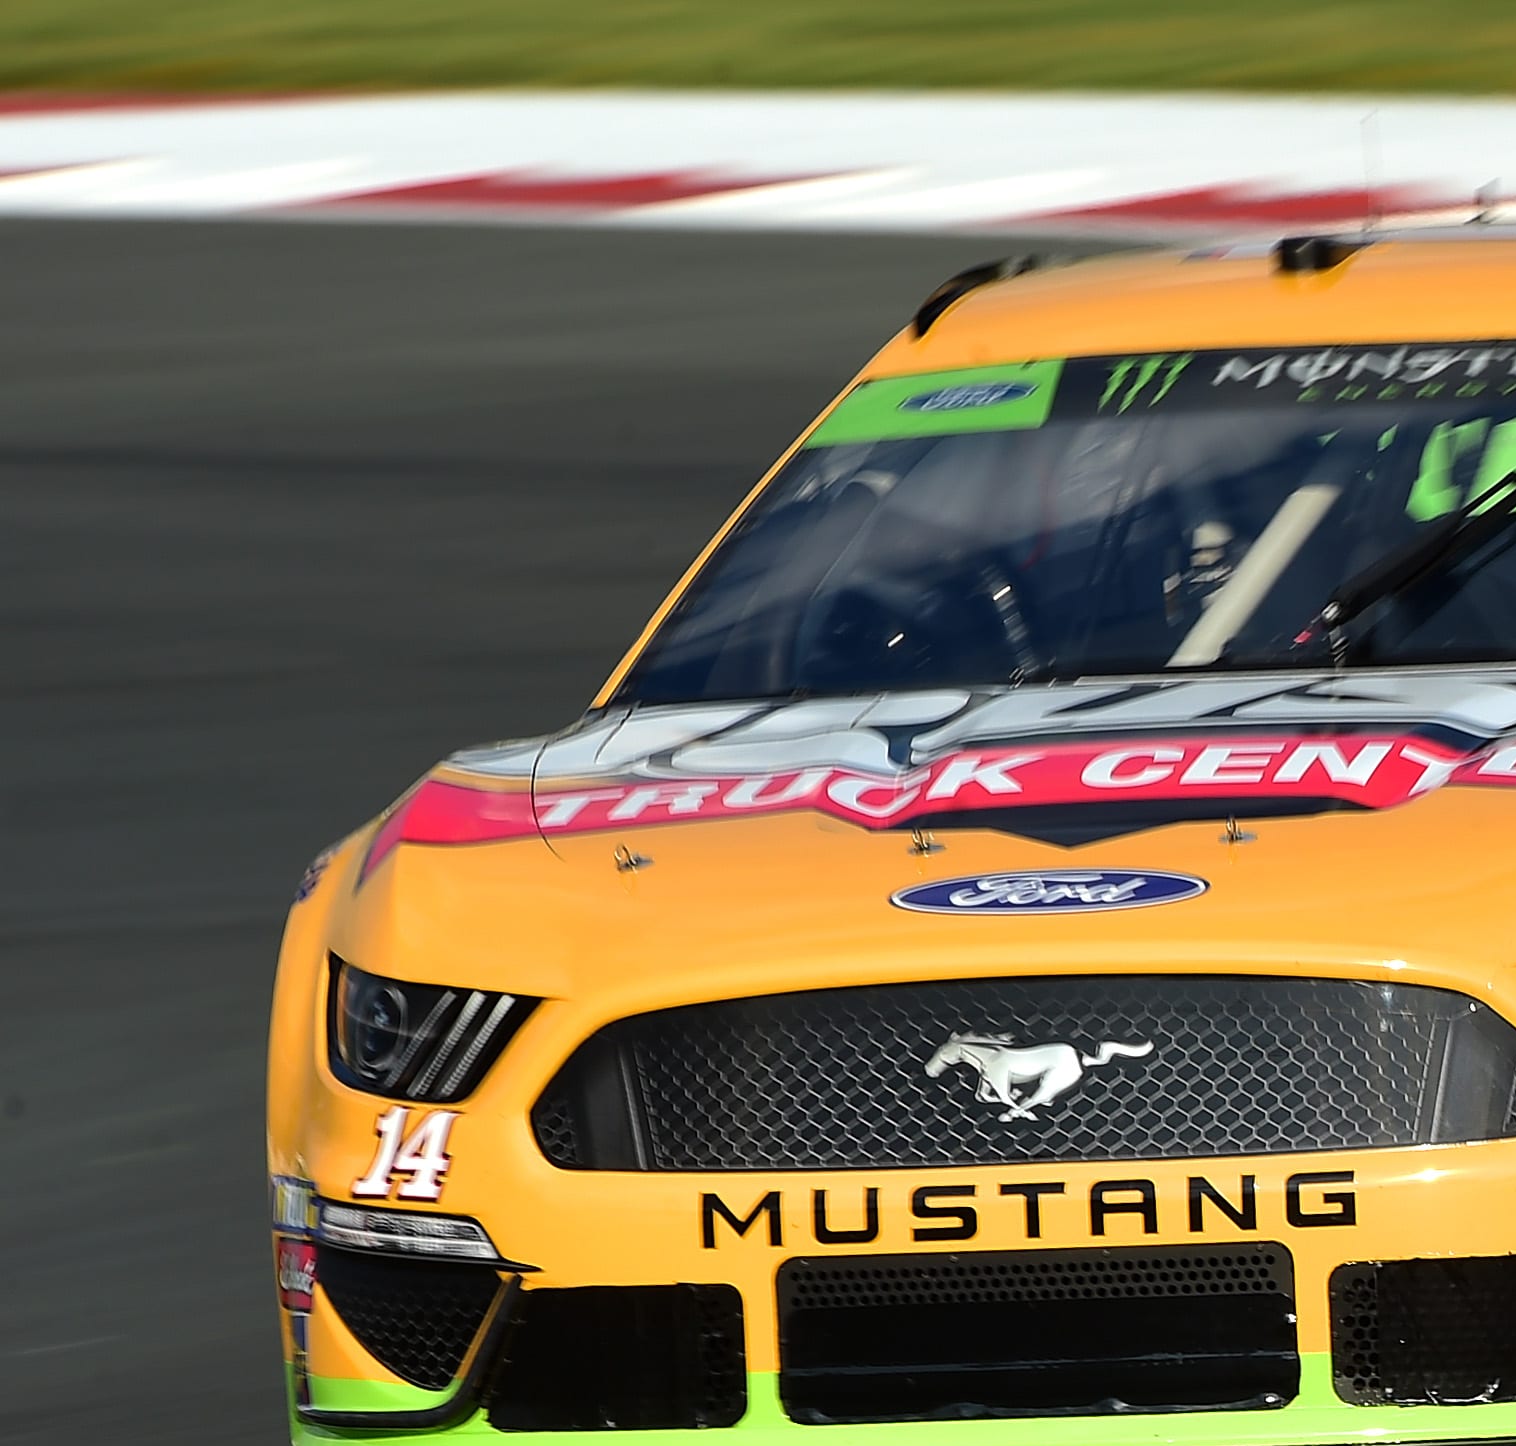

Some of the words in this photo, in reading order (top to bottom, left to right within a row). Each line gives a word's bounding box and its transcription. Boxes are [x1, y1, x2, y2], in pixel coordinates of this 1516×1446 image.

[535, 750, 1047, 828] TRUCK
[948, 871, 1148, 907] Ford
[350, 1105, 461, 1202] 14
[701, 1169, 1358, 1250] MUSTANG
